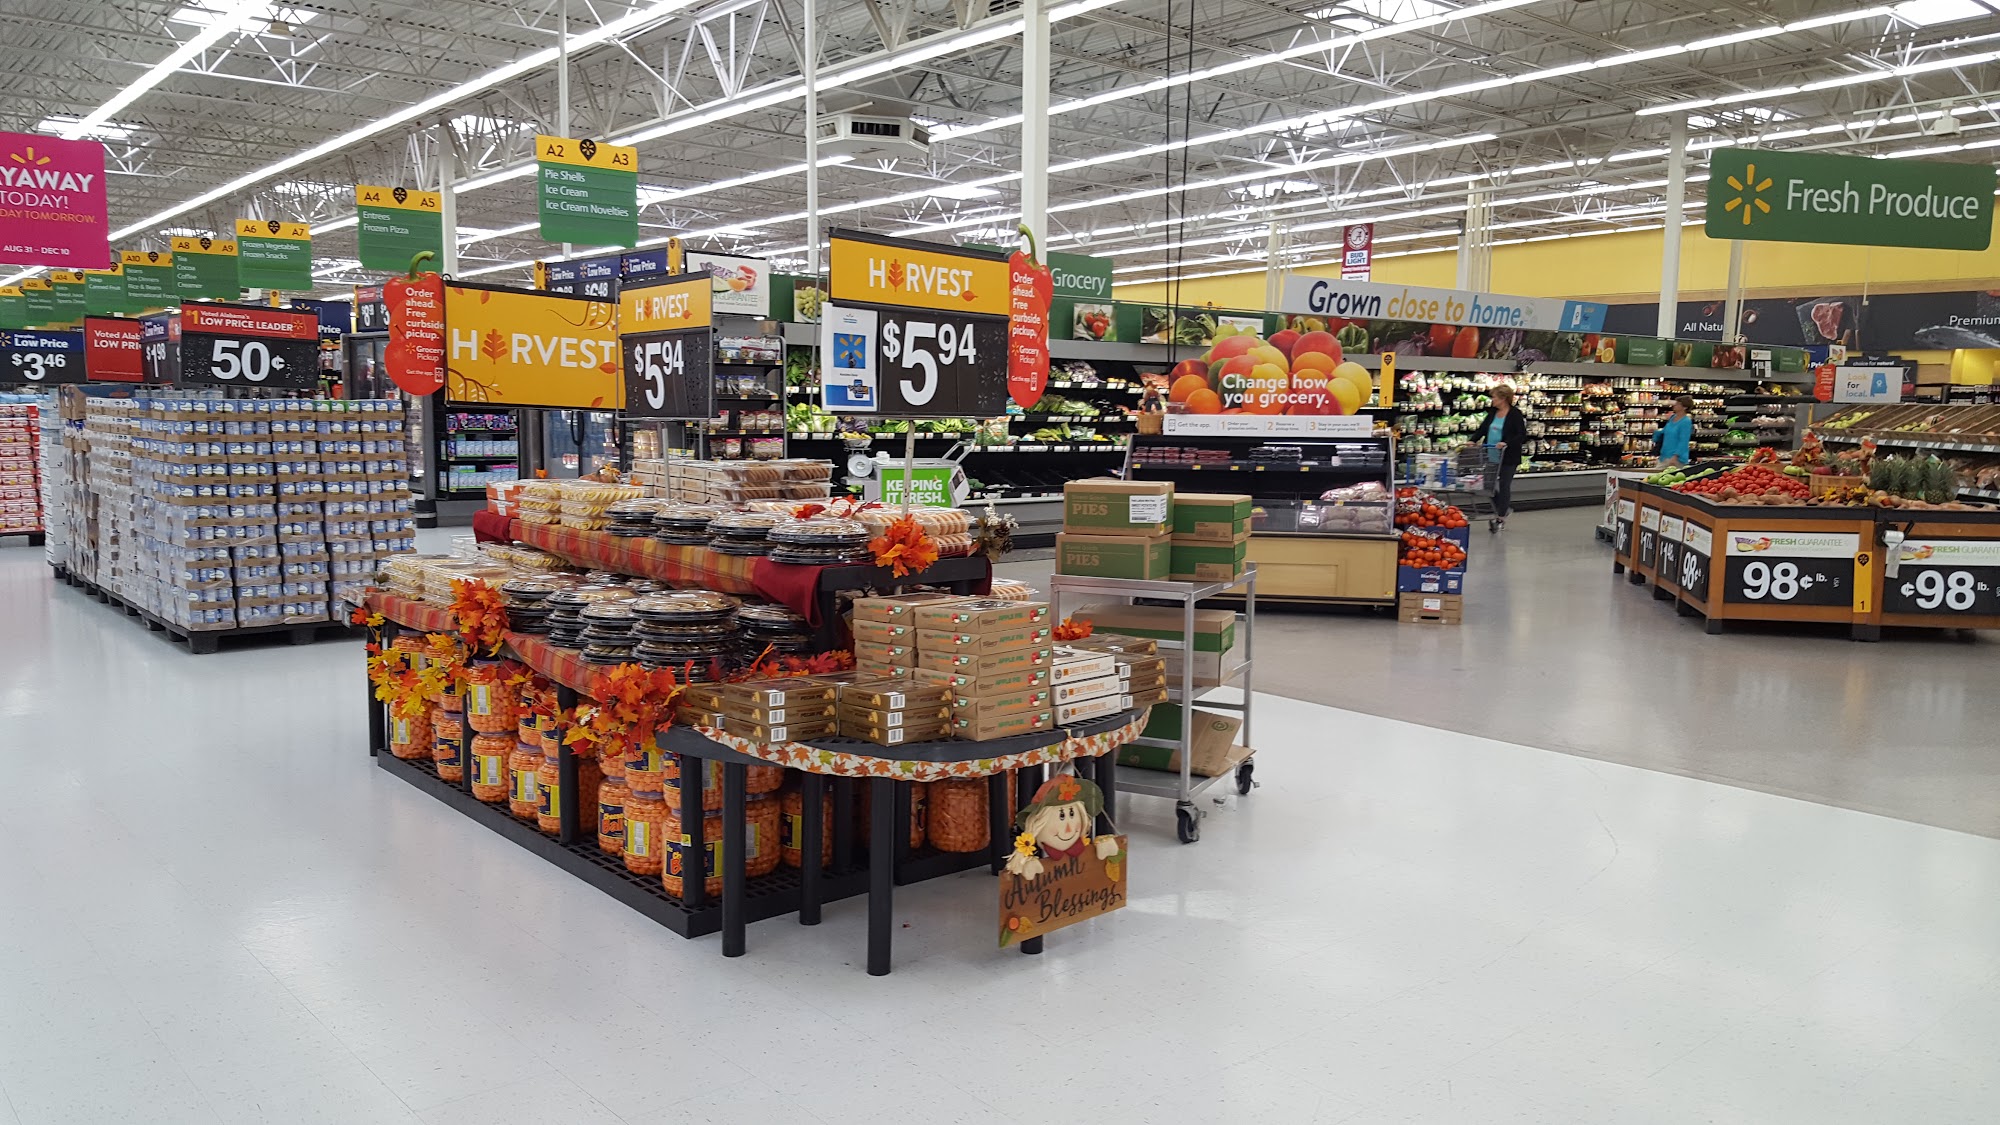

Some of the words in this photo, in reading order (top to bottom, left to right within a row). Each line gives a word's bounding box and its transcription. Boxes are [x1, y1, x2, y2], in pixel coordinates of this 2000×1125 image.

[546, 144, 564, 158] A2
[612, 153, 629, 166] A3
[0, 166, 94, 193] YAWAY
[545, 169, 558, 179] Pie
[560, 171, 585, 182] Shells
[545, 184, 558, 194] Ice
[560, 186, 588, 198] Cream
[0, 190, 69, 209] TODAY!
[364, 192, 380, 202] A4
[1786, 179, 1859, 214] Fresh
[1868, 183, 1979, 220] Produce
[420, 198, 435, 208] A5
[546, 200, 559, 209] Ice
[560, 201, 589, 212] Cream
[590, 205, 629, 217] Novelties
[25, 210, 97, 224] TOMORROW.
[363, 211, 390, 220] Entrees
[243, 225, 257, 233] A6
[292, 228, 305, 236] A7
[363, 223, 388, 232] Frozen
[389, 226, 409, 234] Pizza
[4, 245, 23, 253] AUG
[41, 246, 60, 255] DEC
[242, 241, 264, 249] Frozen
[265, 242, 300, 251] Vegetables
[642, 260, 656, 271] Price
[1012, 272, 1034, 284] Order
[1051, 267, 1107, 295] Grocery
[405, 287, 434, 298] Order
[1012, 286, 1035, 298] ahead.
[406, 299, 436, 308] ahead.
[1013, 298, 1028, 310] Free
[1308, 280, 1381, 316] Grown
[1387, 289, 1438, 321] close
[1444, 295, 1465, 322] to
[1469, 295, 1524, 326] home.
[219, 311, 250, 319] Alabama's
[406, 308, 427, 318] Free
[1012, 313, 1041, 324] curbside
[200, 318, 224, 326] LOW
[225, 319, 254, 329] PRICE
[256, 322, 293, 332] LEADER
[318, 324, 341, 334] Price
[406, 320, 445, 330] curbside
[1683, 322, 1697, 331] All
[1699, 322, 1723, 331] Natu
[94, 330, 120, 339] Voted
[123, 332, 141, 340] Alab
[405, 329, 439, 341] pickup.
[1012, 325, 1037, 339] pickup.
[14, 337, 39, 347] Low
[40, 339, 69, 348] Price
[94, 340, 120, 348] LOW
[416, 345, 445, 355] Grocery
[1019, 345, 1039, 357] Grocery
[417, 353, 439, 363] Pickup
[1020, 354, 1036, 365] Pickup
[1848, 373, 1867, 381] Look
[1222, 374, 1288, 392] Change
[1292, 375, 1328, 389] how
[1224, 391, 1254, 407] you
[1258, 392, 1330, 408] grocery.
[1846, 390, 1868, 398] local.
[1267, 421, 1273, 430] 2
[1309, 421, 1316, 430] 3
[886, 480, 942, 491] KEPING
[886, 492, 899, 504] IT
[1071, 503, 1108, 516] PIES
[1770, 538, 1797, 546] FRESH
[1798, 538, 1843, 546] GUARANTEE
[1932, 545, 1960, 553] FRESH
[1066, 553, 1099, 567] PIES
[1815, 573, 1828, 582] lb.
[1977, 582, 1990, 591] lb.
[1860, 600, 1865, 610] 1
[1005, 856, 1085, 910] Autumn
[1035, 884, 1123, 924] Blessings
